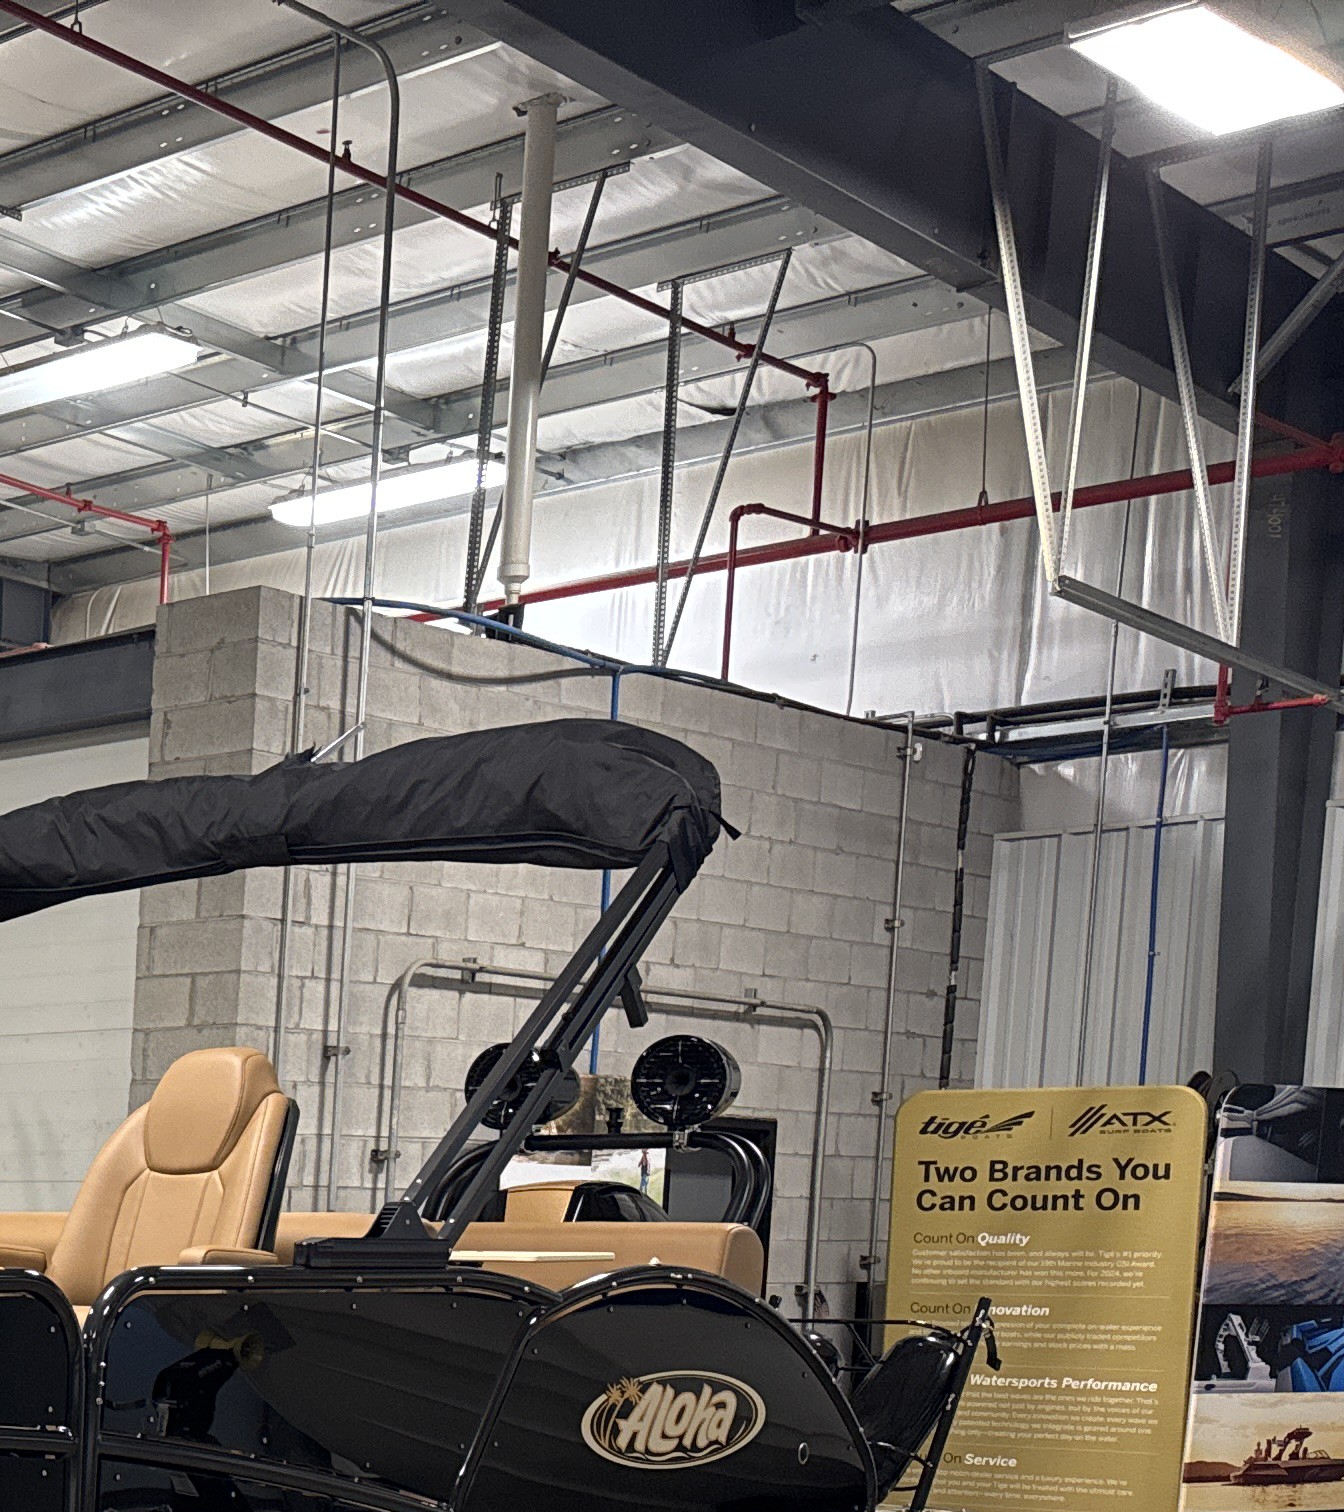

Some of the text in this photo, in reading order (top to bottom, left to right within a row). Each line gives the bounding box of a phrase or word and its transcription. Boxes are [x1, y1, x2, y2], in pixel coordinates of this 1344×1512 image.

[1100, 1110, 1173, 1127] ATX
[917, 1156, 1172, 1183] Two Brands You
[915, 1187, 1141, 1212] Can Count On
[913, 1231, 1031, 1247] Count On Quality
[910, 1302, 1050, 1317] Count On novation
[970, 1373, 1158, 1393] Watersports Performance
[943, 1452, 962, 1464] On
[963, 1453, 1017, 1467] Service
